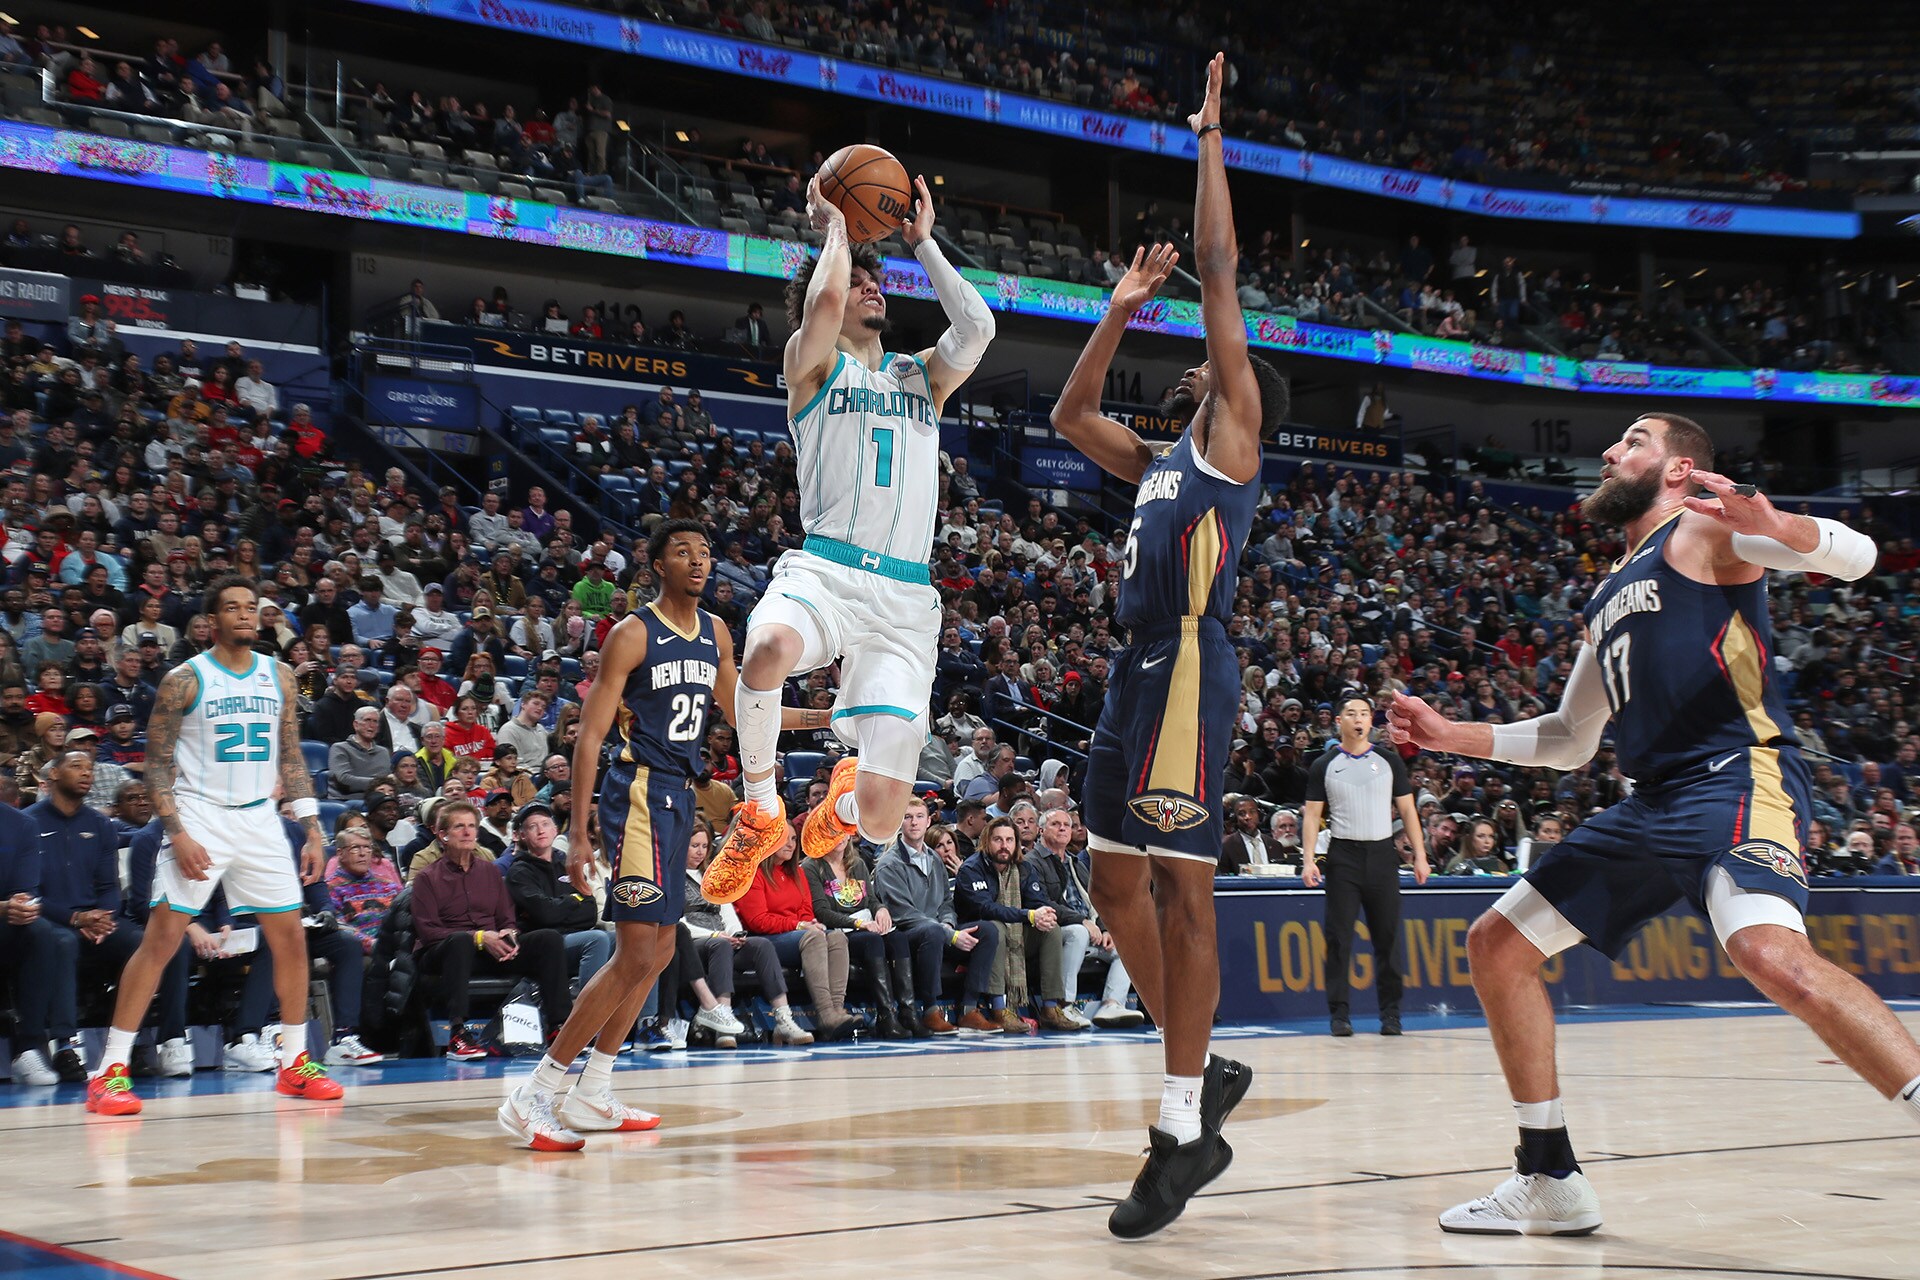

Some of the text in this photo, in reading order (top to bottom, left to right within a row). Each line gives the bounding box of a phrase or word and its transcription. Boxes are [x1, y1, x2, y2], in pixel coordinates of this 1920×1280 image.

[929, 91, 973, 115] LIGHT
[1019, 106, 1129, 142] MADE TO Chill
[18, 282, 59, 302] RADIO
[103, 283, 167, 300] NEWS TALK
[530, 343, 688, 378] BETRIVERS
[387, 390, 459, 408] GREY GOOSE
[828, 387, 933, 428] CHARLOTTE
[1278, 432, 1388, 457] BETRIVERS
[1530, 418, 1572, 456] 115
[871, 427, 894, 488] 1
[1036, 458, 1085, 472] GREY GOOSE
[1123, 516, 1143, 580] 5
[1604, 578, 1663, 632] ORLEANS
[651, 659, 718, 691] NEW ORLEAN
[1603, 631, 1632, 714] 17
[204, 695, 279, 720] CHARLOTTE
[668, 693, 706, 742] 25
[213, 722, 271, 763] 25
[972, 880, 988, 892] HH
